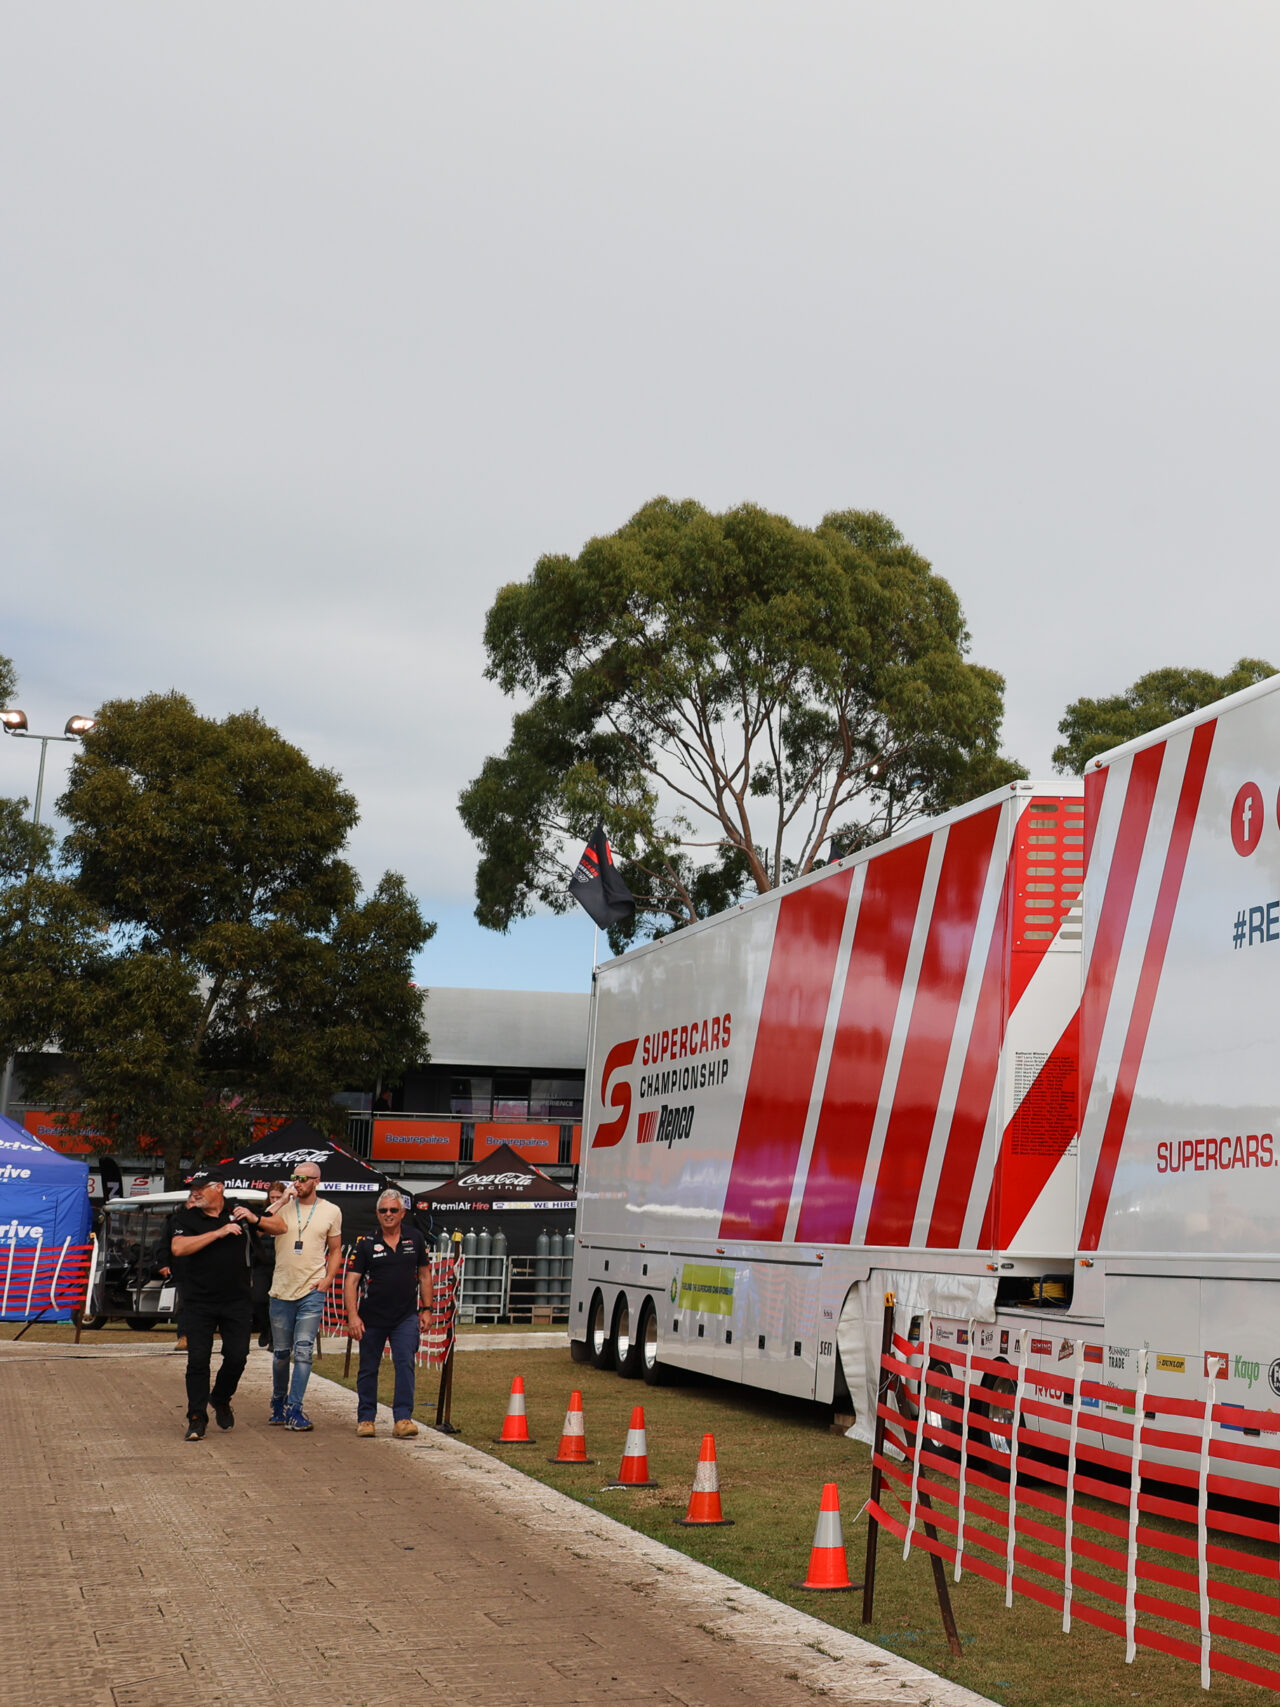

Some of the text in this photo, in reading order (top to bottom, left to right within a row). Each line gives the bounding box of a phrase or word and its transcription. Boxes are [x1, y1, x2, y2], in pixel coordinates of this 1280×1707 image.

[642, 1013, 732, 1066] SUPERCARS
[640, 1058, 729, 1098] CHAMPIONSHIP
[656, 1104, 695, 1150] Repco
[384, 1133, 450, 1145] Beaurepaires
[486, 1136, 549, 1147] Beaurepaires
[251, 1180, 271, 1190] Hire
[345, 1183, 374, 1191] HIRE
[432, 1201, 490, 1211] PremiAir Hire
[1108, 1356, 1125, 1370] TRADE
[1161, 1359, 1185, 1369] DUNLOP
[1233, 1354, 1260, 1389] Kayo
